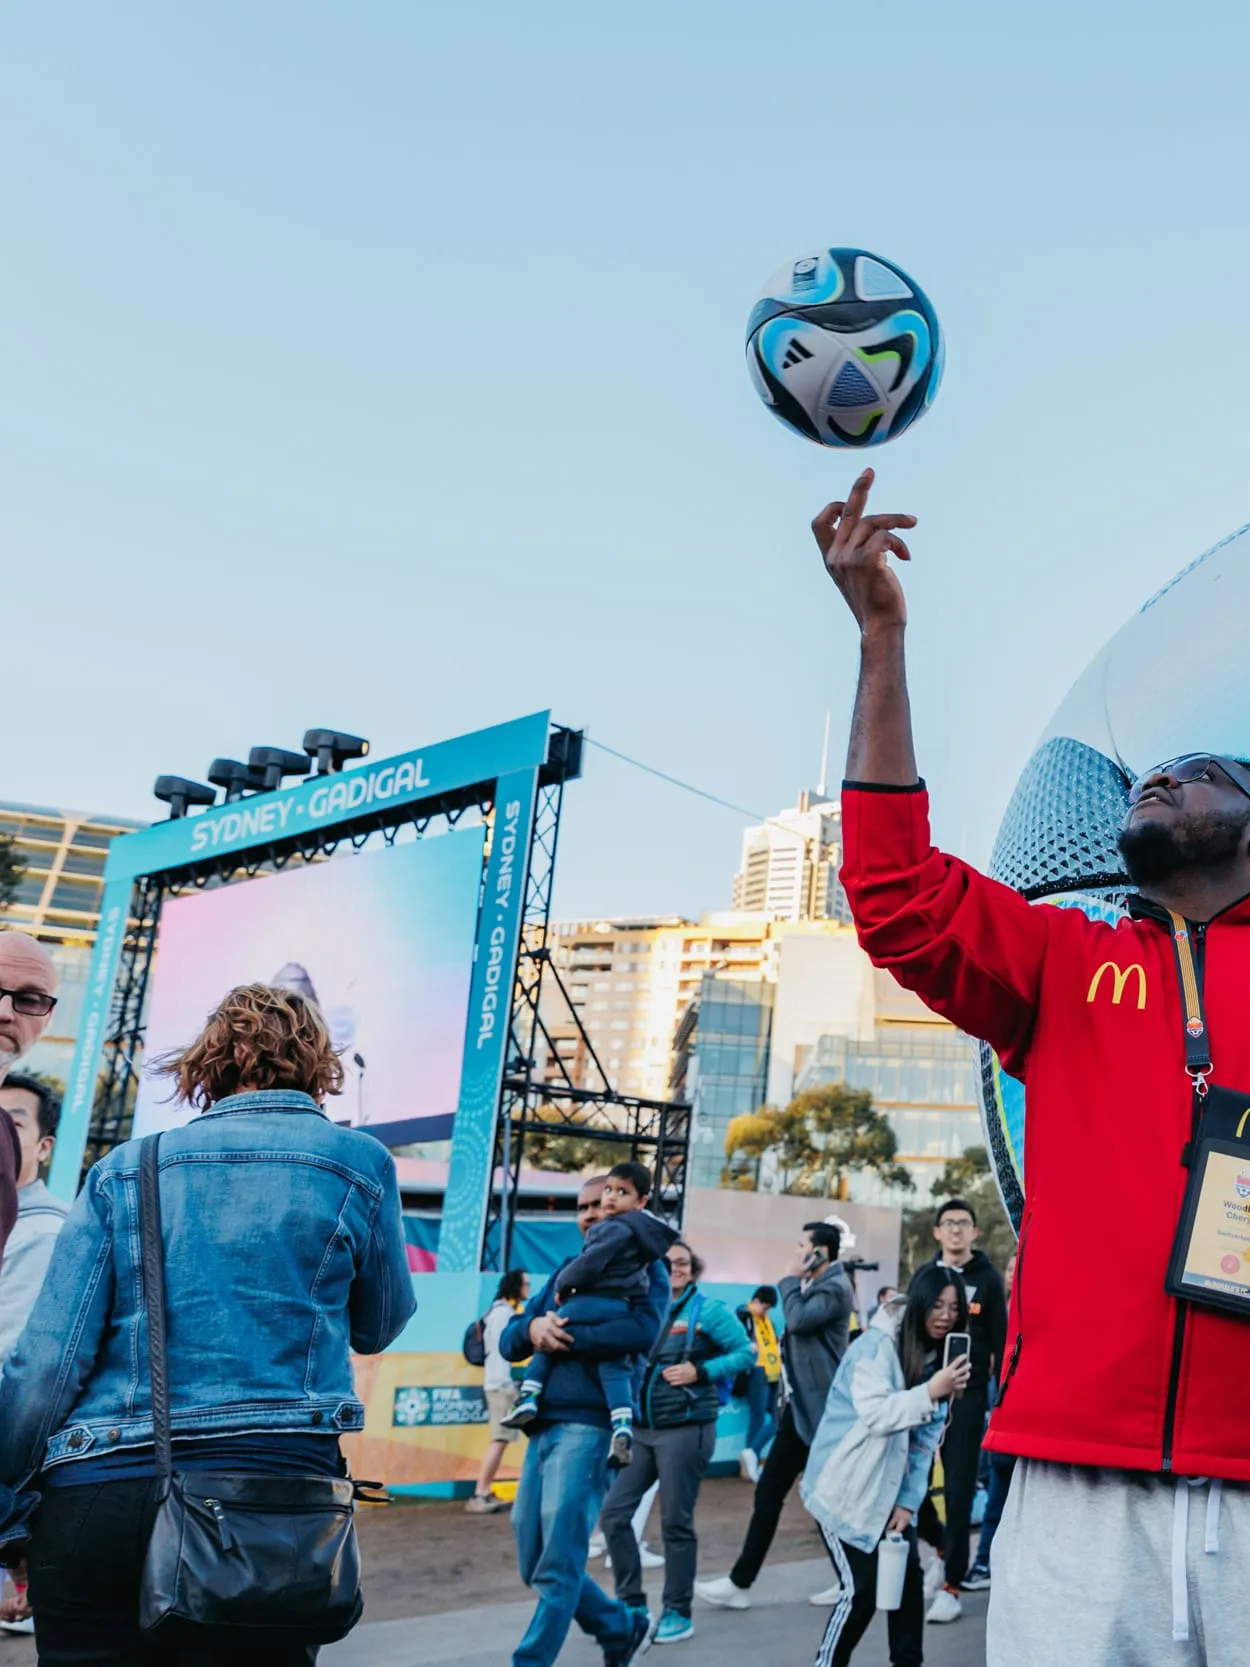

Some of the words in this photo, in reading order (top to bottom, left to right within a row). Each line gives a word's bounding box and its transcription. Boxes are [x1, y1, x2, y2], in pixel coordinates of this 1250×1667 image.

[190, 797, 294, 851] SYDNEY
[308, 758, 430, 819] GADIGAL
[495, 799, 521, 909] SYDNEY
[477, 926, 506, 1050] GADIGAL
